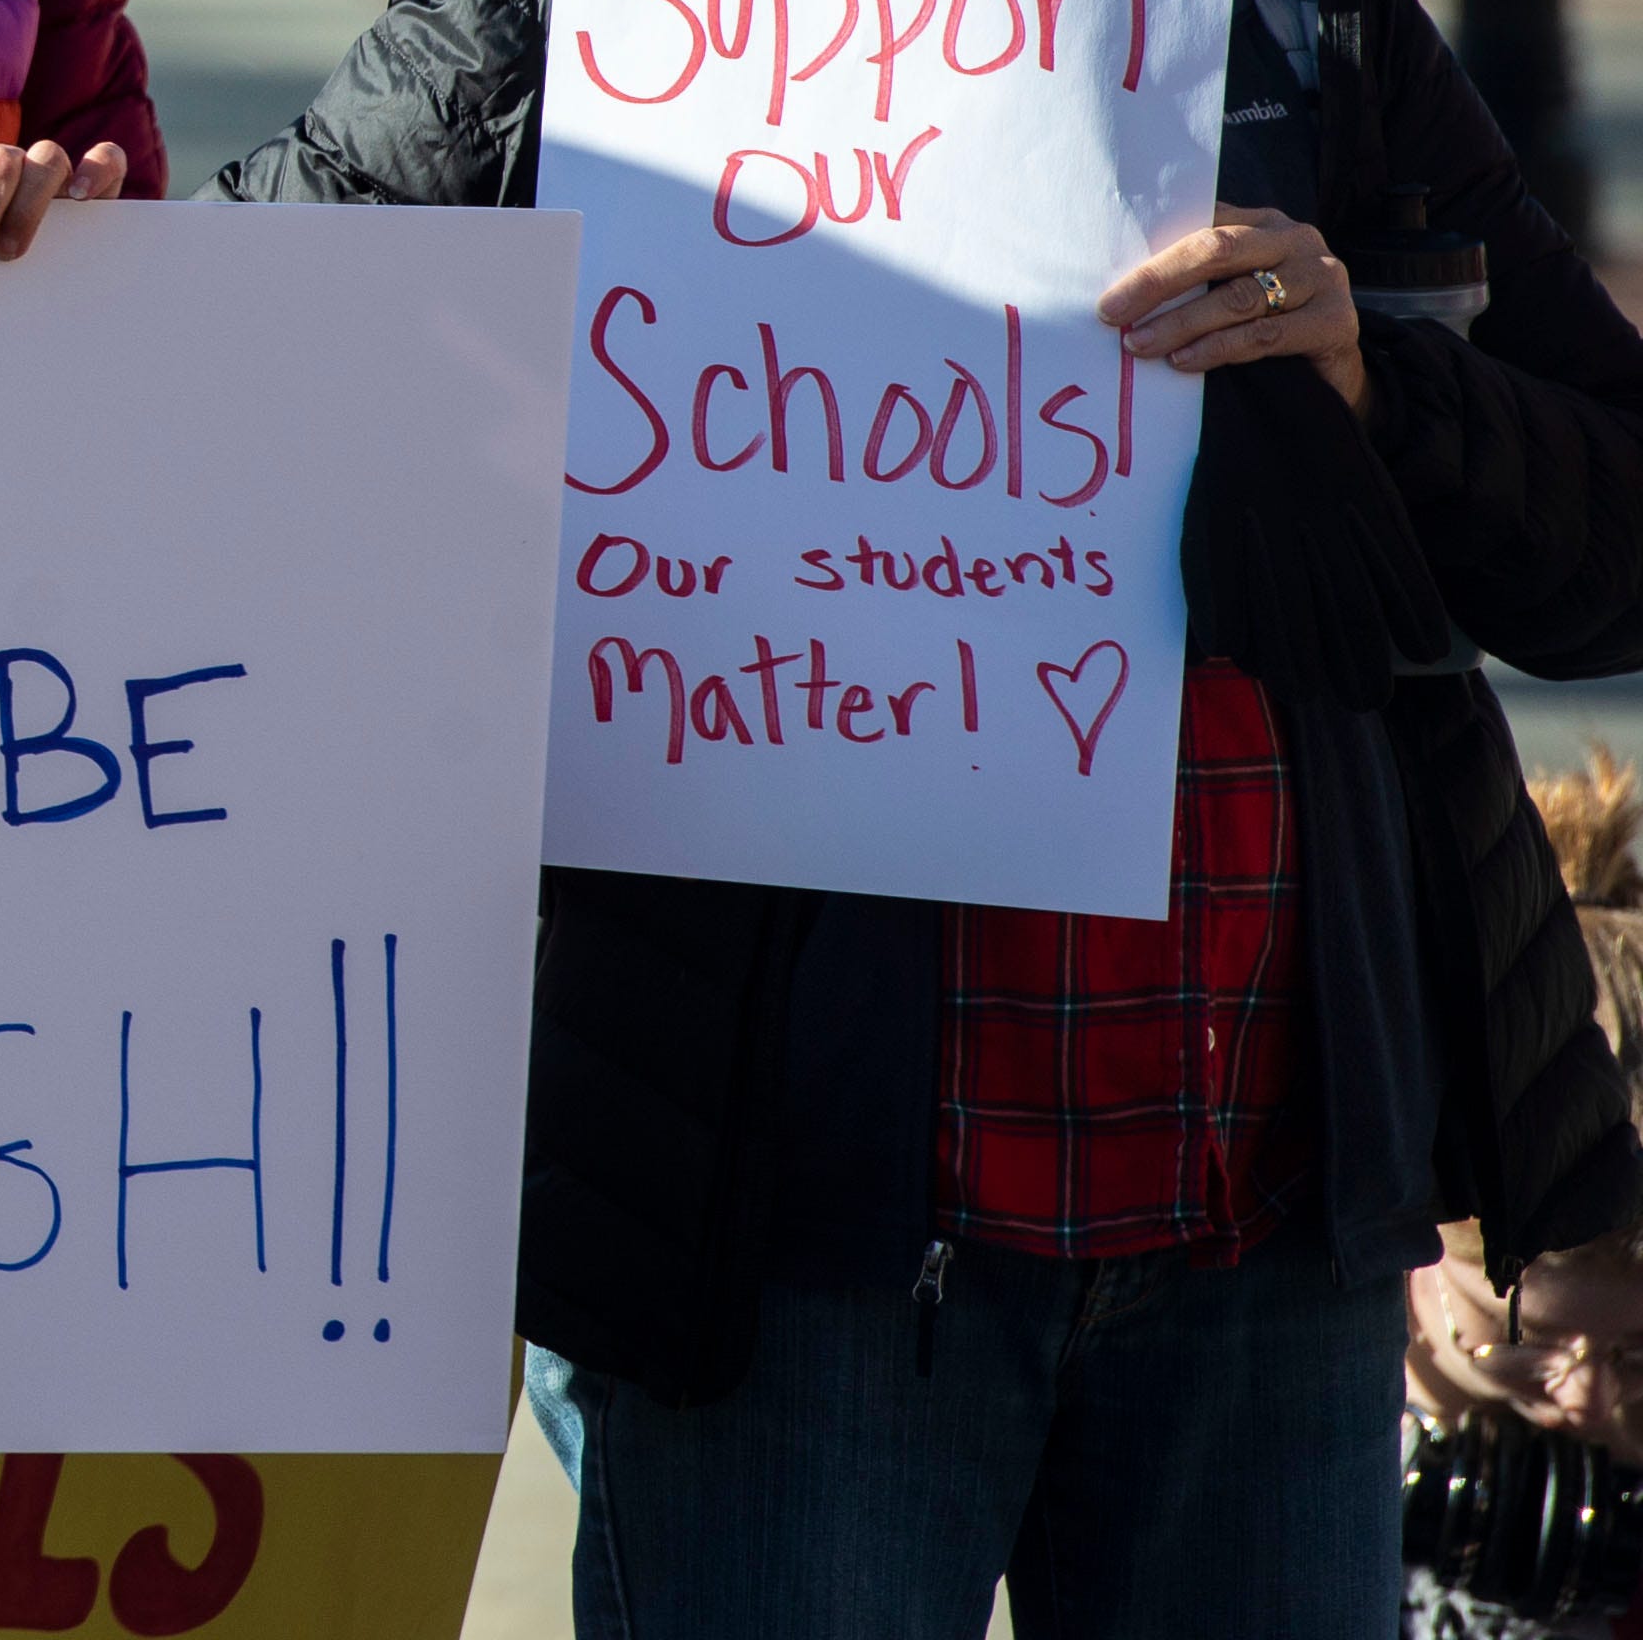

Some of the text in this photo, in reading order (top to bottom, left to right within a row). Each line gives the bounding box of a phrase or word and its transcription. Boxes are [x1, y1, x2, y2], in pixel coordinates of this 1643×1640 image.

[1223, 98, 1288, 124] umbia
[564, 285, 1136, 516] Schools!
[575, 533, 1115, 598] Our students
